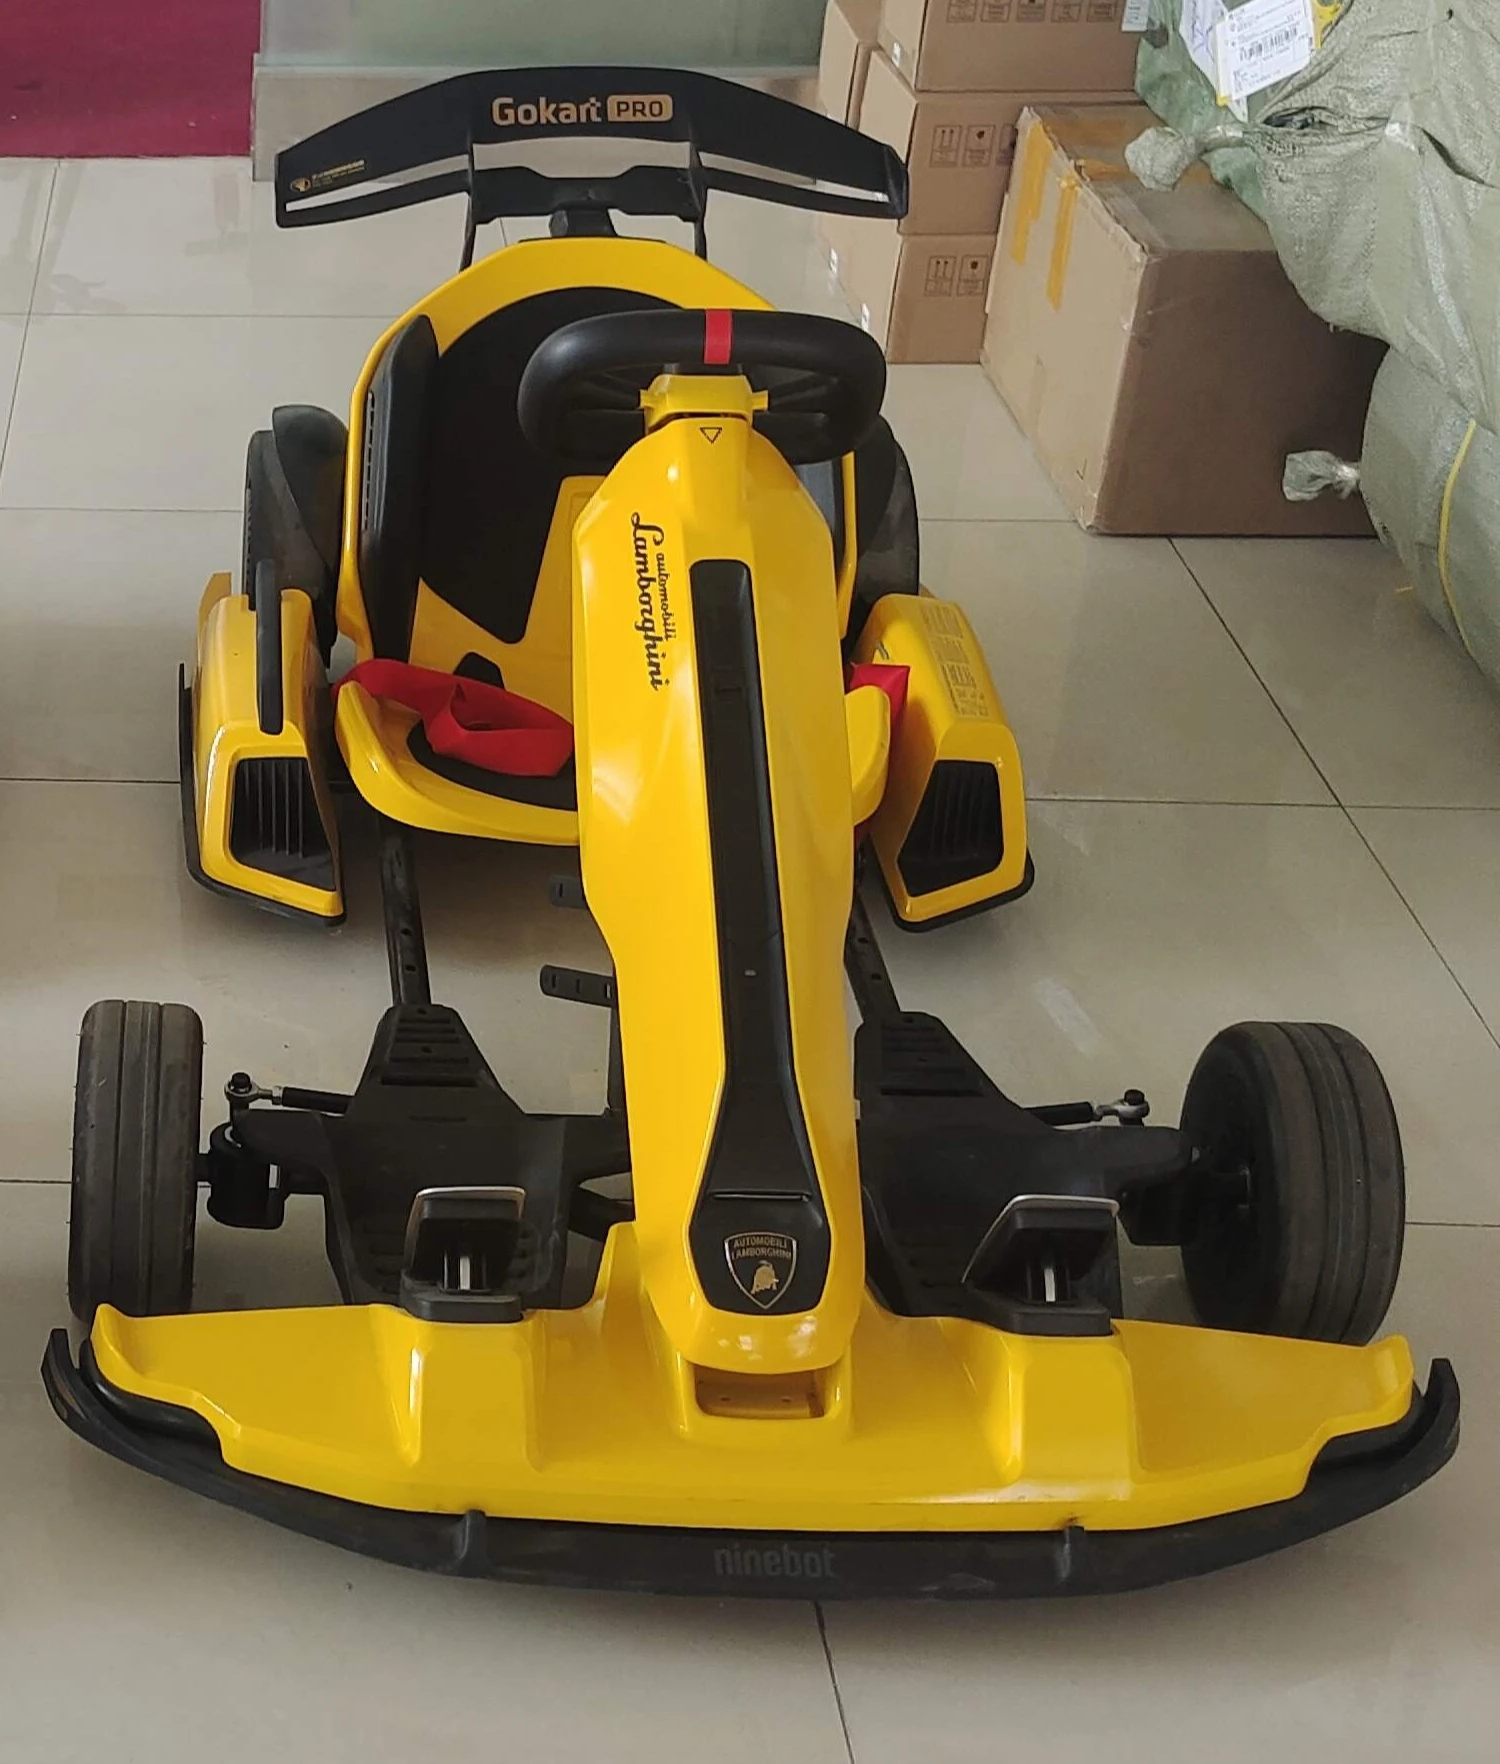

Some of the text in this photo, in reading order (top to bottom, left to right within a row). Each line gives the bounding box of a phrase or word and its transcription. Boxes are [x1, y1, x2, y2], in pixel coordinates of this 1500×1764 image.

[491, 95, 663, 126] Gokart PRO
[630, 511, 671, 692] Lamborghini
[731, 1246, 792, 1261] LAMBORGHINI
[733, 1235, 788, 1249] AUTOMOBILI
[713, 1543, 838, 1578] ninebot
